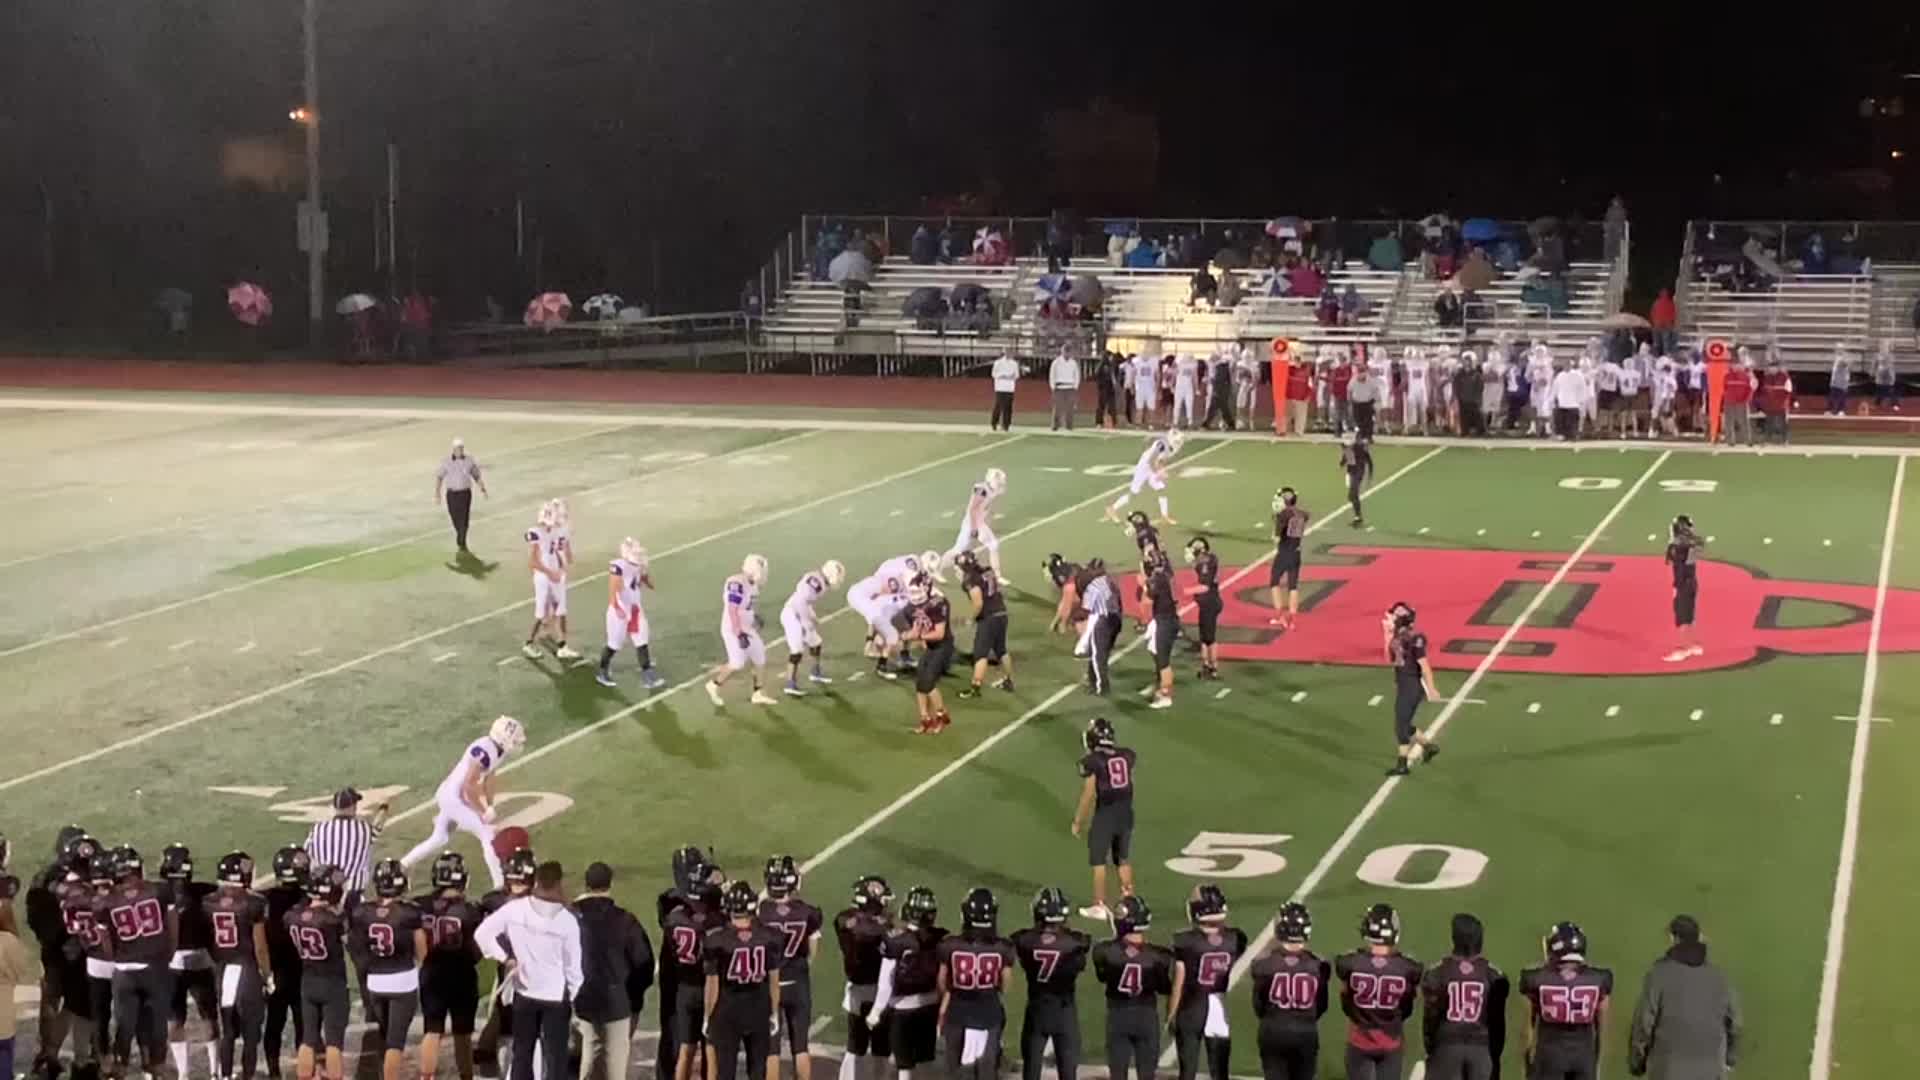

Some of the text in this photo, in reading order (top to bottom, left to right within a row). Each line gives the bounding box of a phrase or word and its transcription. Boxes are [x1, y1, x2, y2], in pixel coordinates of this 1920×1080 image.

[1108, 757, 1128, 788] 9
[111, 898, 163, 941] 99
[213, 912, 238, 948] 5
[289, 924, 328, 960] 13
[368, 922, 395, 957] 3
[727, 945, 766, 984] 41
[952, 951, 1002, 990] 88
[1033, 949, 1060, 983] 7
[1117, 963, 1143, 996] 4
[1269, 973, 1319, 1009] 40
[1350, 974, 1406, 1009] 26
[1446, 981, 1485, 1023] 15
[1539, 985, 1600, 1024] 53
